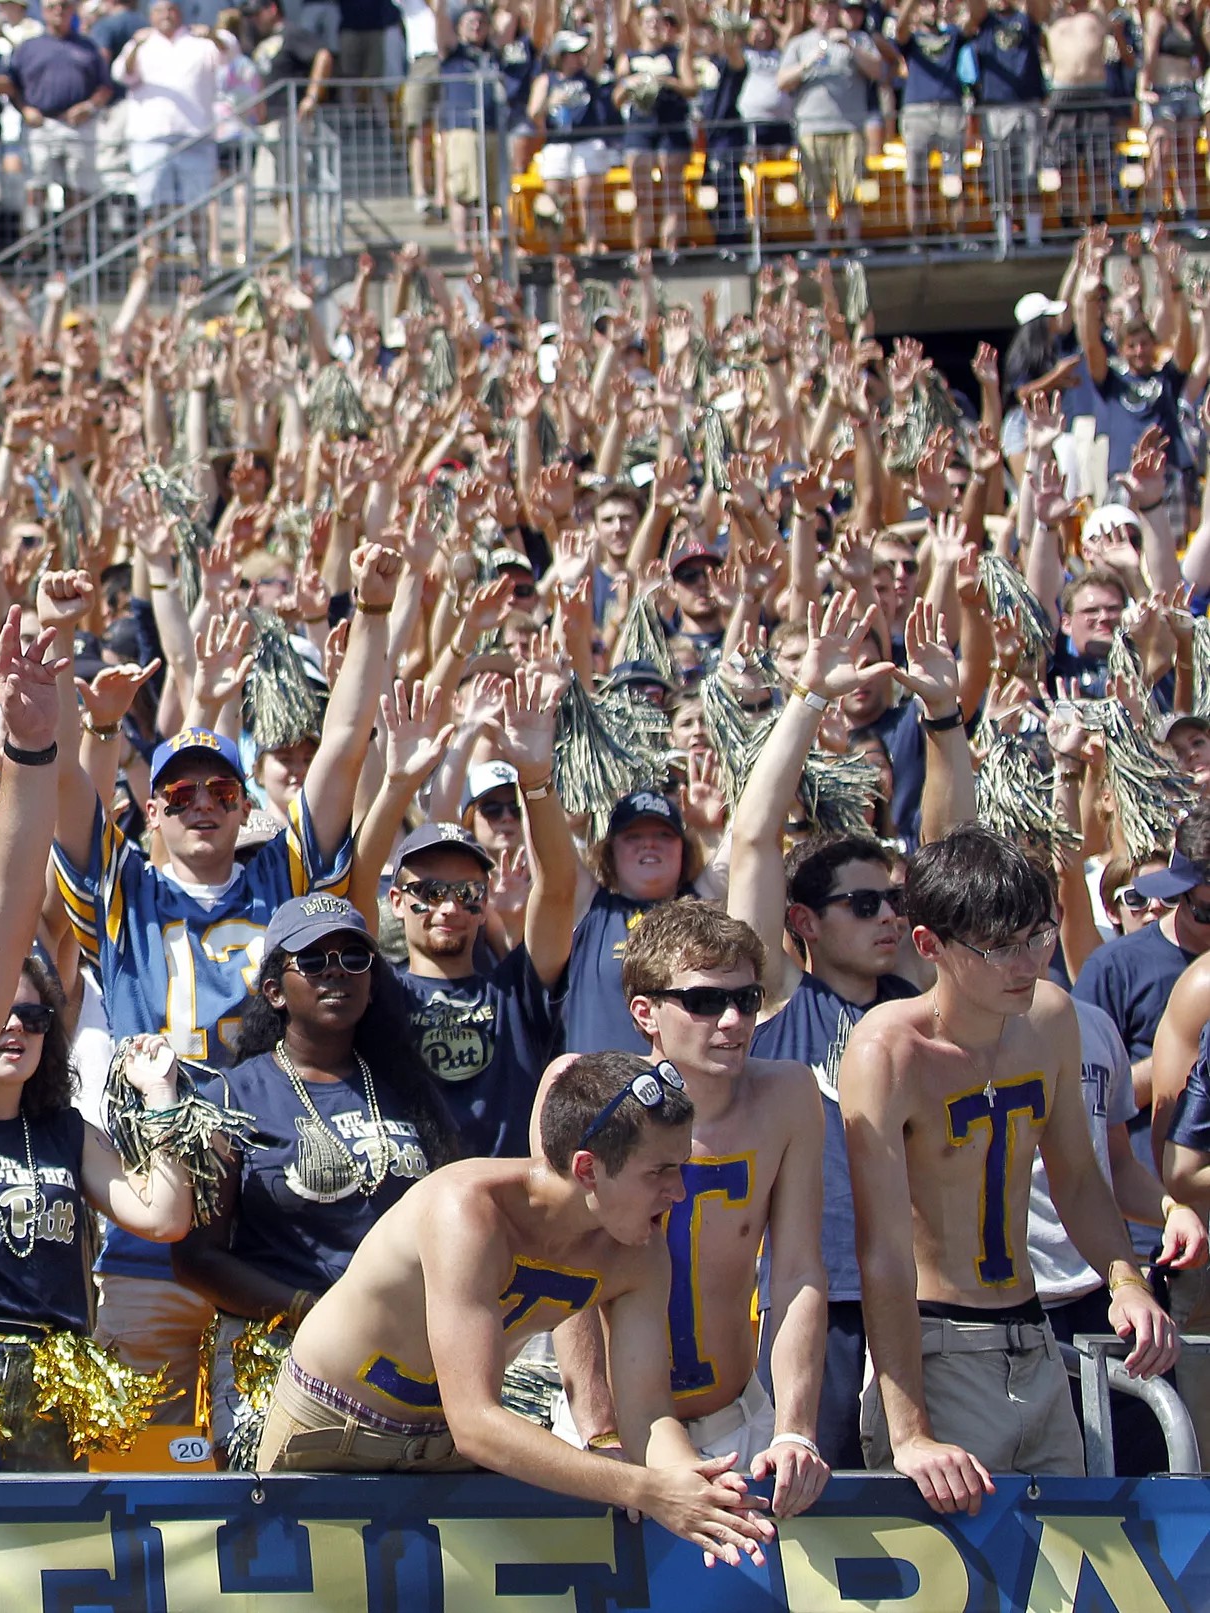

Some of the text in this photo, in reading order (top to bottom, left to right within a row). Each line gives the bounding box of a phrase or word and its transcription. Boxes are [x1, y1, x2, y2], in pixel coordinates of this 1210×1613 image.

[166, 730, 221, 752] Pitt
[300, 896, 350, 917] PITT
[423, 1042, 480, 1071] Pitt
[331, 1109, 366, 1131] THE
[352, 1138, 430, 1180] Pitt
[943, 1071, 1048, 1289] T
[177, 1442, 203, 1458] 20
